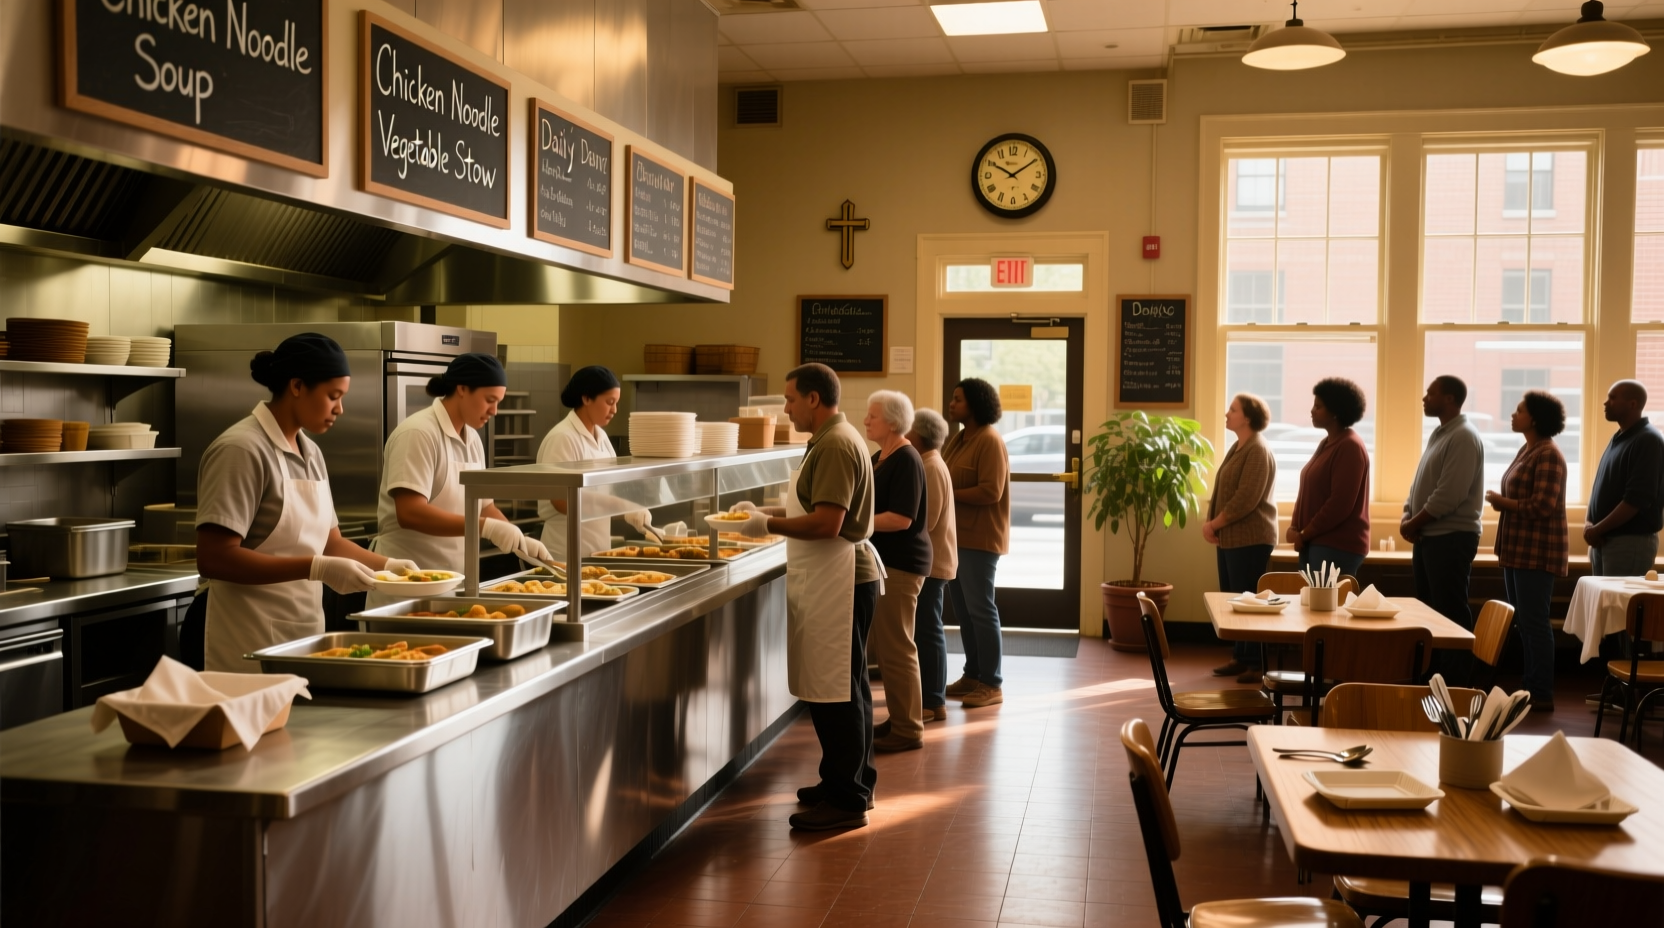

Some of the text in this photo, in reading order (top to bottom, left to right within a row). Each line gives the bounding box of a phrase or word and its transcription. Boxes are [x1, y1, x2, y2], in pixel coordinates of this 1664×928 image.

[101, 0, 312, 74] icken Noodle
[134, 33, 214, 124] Soup
[376, 43, 500, 137] Chicken Noodle
[378, 109, 496, 189] Vegetable Stow
